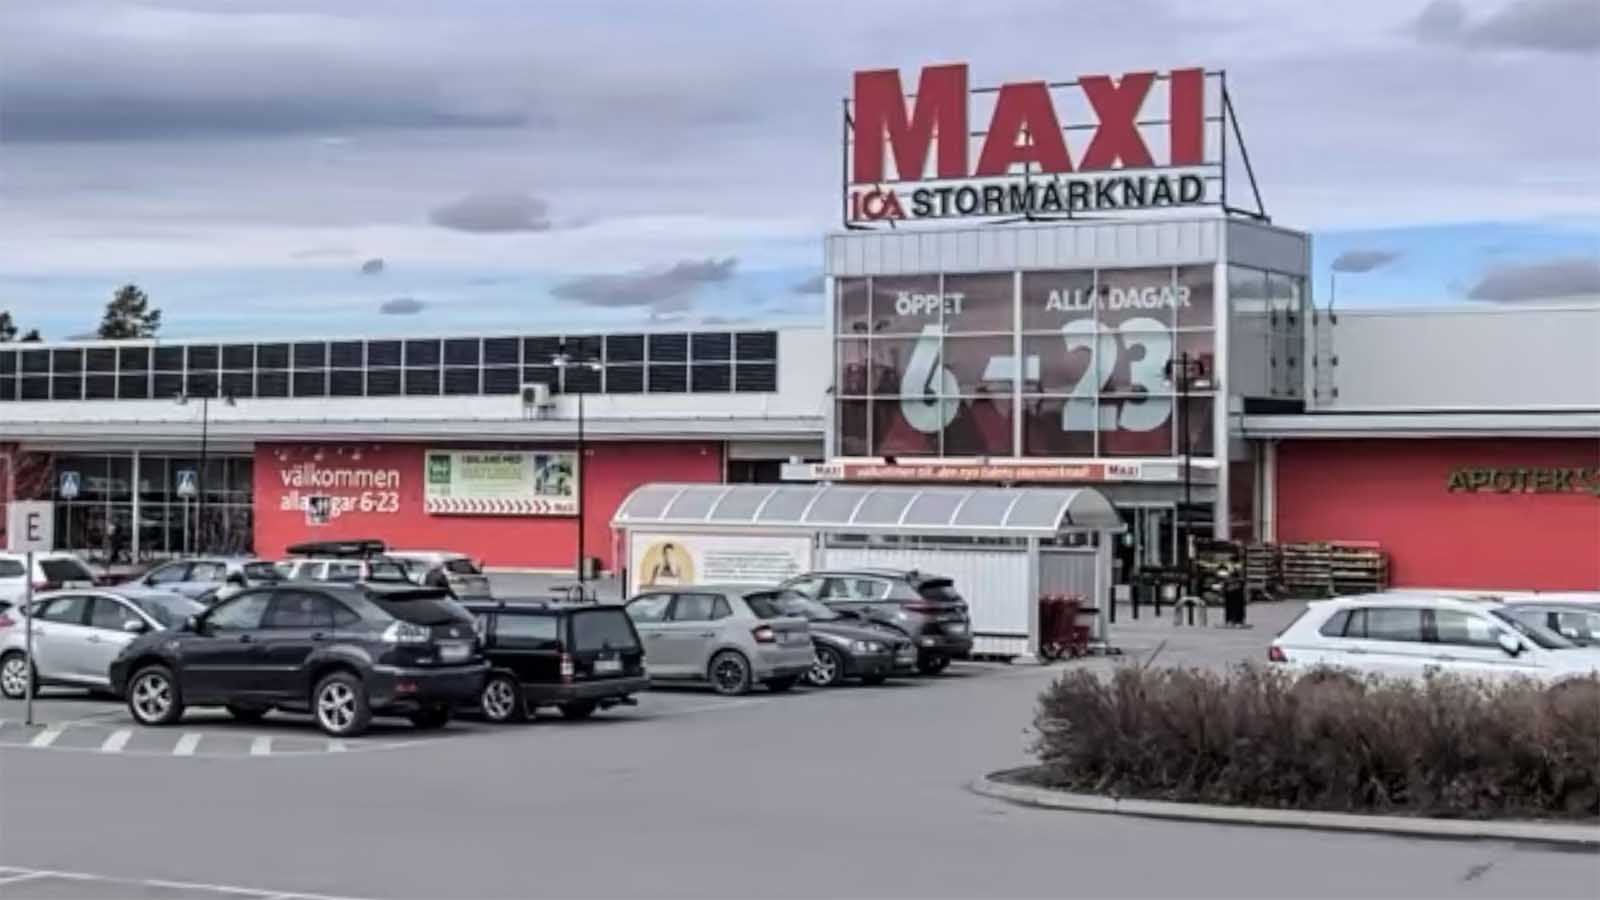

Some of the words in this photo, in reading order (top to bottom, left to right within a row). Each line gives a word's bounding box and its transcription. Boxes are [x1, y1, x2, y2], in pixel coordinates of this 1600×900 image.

[854, 64, 1205, 183] MAXI
[853, 189, 906, 221] ICA
[911, 173, 1205, 216] STORMARKNAD
[895, 290, 966, 316] ÖPPET
[1045, 288, 1104, 312] ALLA
[1107, 285, 1192, 310] DAGAR
[901, 323, 961, 433] 6
[1061, 317, 1175, 432] 23
[281, 462, 399, 488] välkommen
[1446, 466, 1573, 494] APOTEK
[359, 491, 399, 513] 6-23
[27, 513, 41, 541] E
